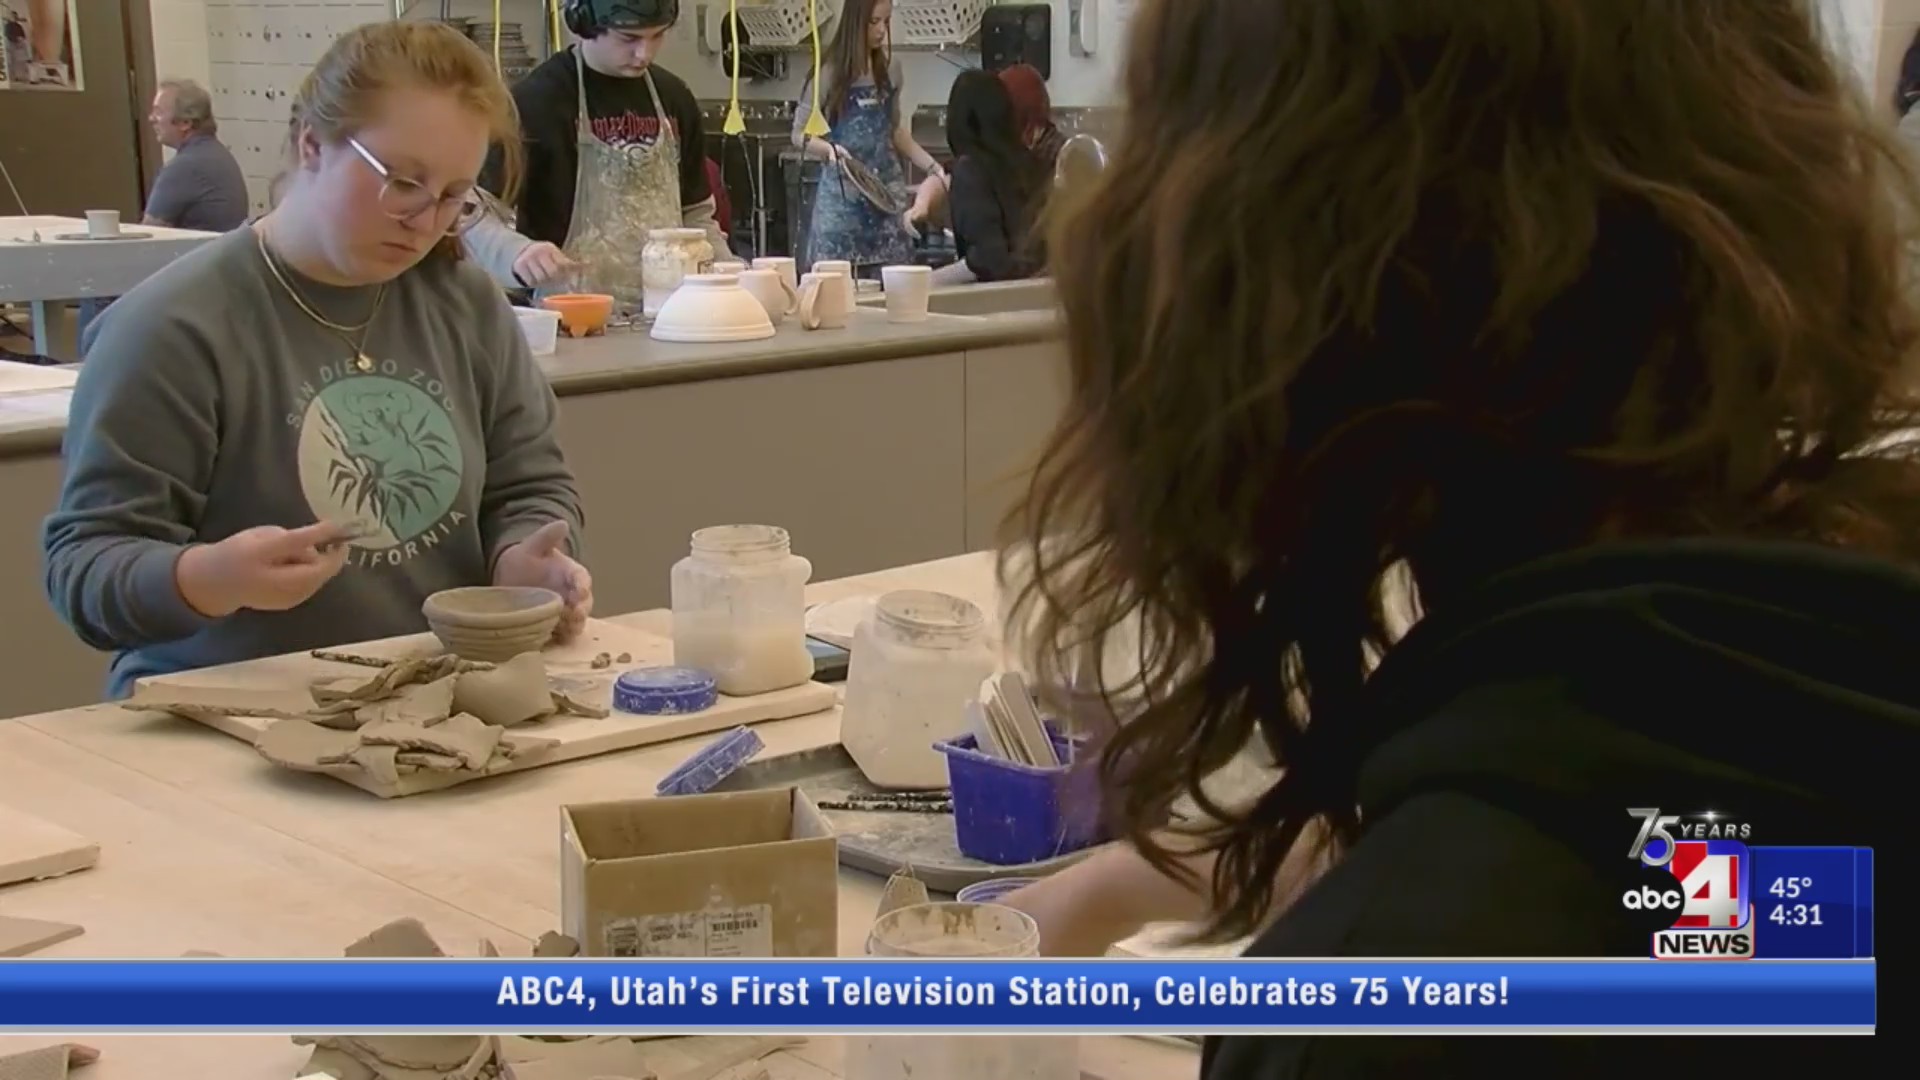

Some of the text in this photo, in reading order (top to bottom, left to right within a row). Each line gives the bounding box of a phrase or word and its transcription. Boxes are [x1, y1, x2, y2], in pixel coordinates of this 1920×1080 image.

[286, 381, 315, 428] SN
[320, 358, 398, 383] DIEO
[343, 510, 467, 569] LIFORNIA
